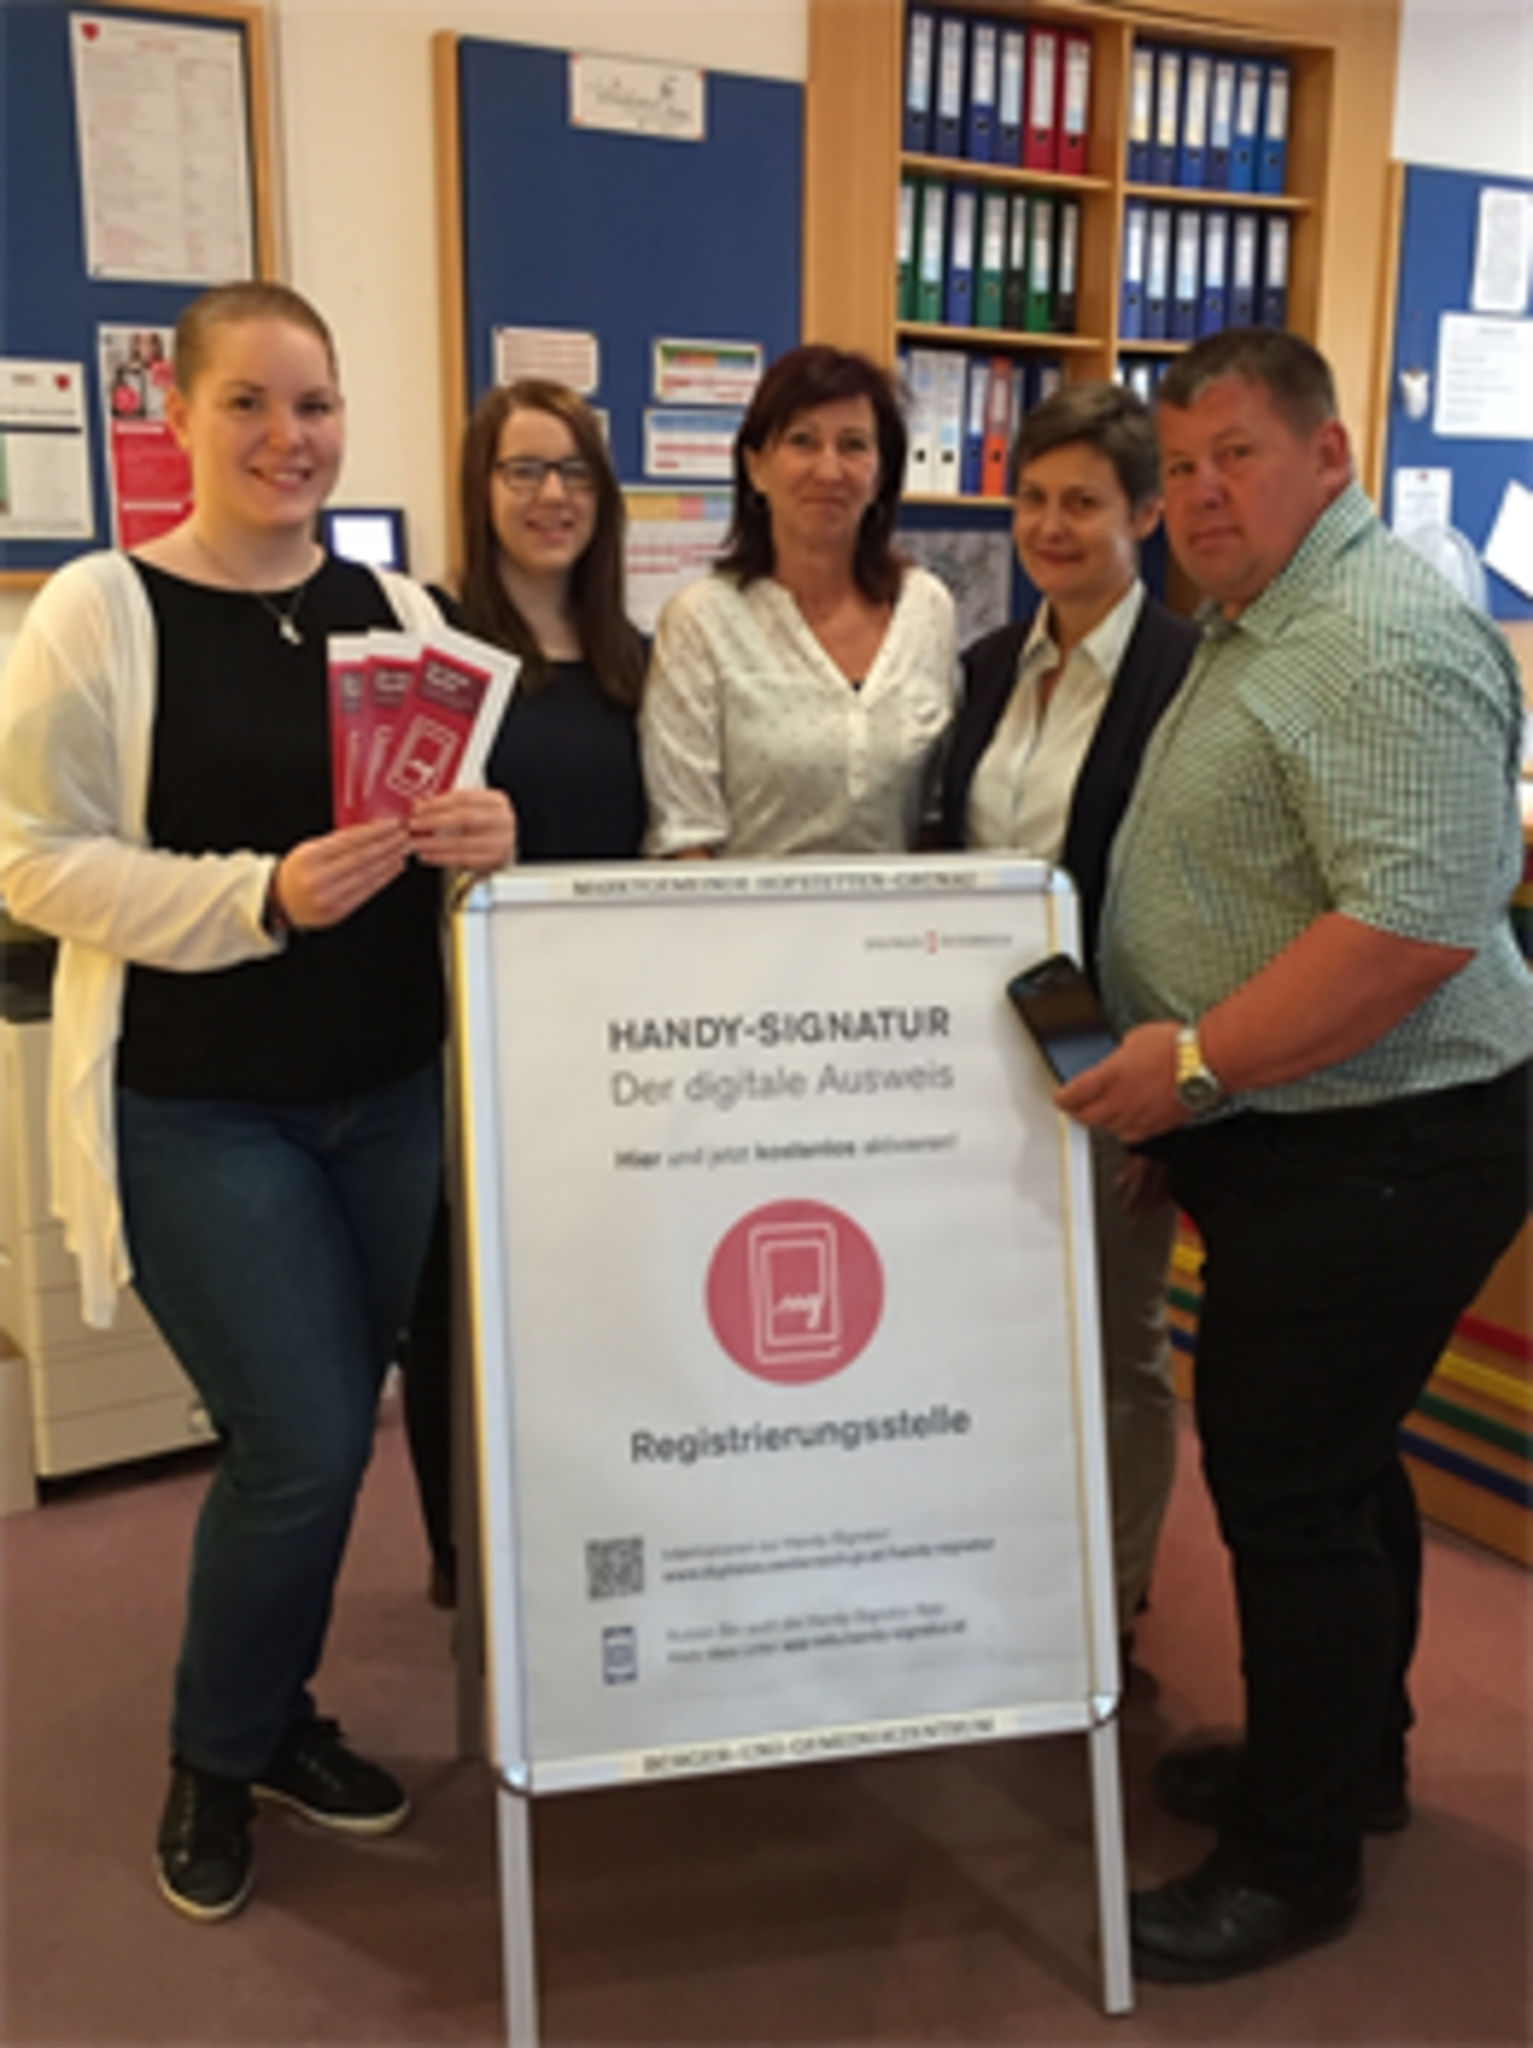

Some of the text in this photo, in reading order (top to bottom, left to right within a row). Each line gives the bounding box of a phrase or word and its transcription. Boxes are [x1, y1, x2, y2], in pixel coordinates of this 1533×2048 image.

[608, 1006, 951, 1052] HANDY-SIGNATUR
[611, 1059, 956, 1113] Der digitale Ausweis
[614, 1148, 662, 1169] Hier
[667, 1147, 704, 1167] und
[754, 1139, 855, 1162] kostenlos
[630, 1405, 972, 1465] Registrierungsstelle
